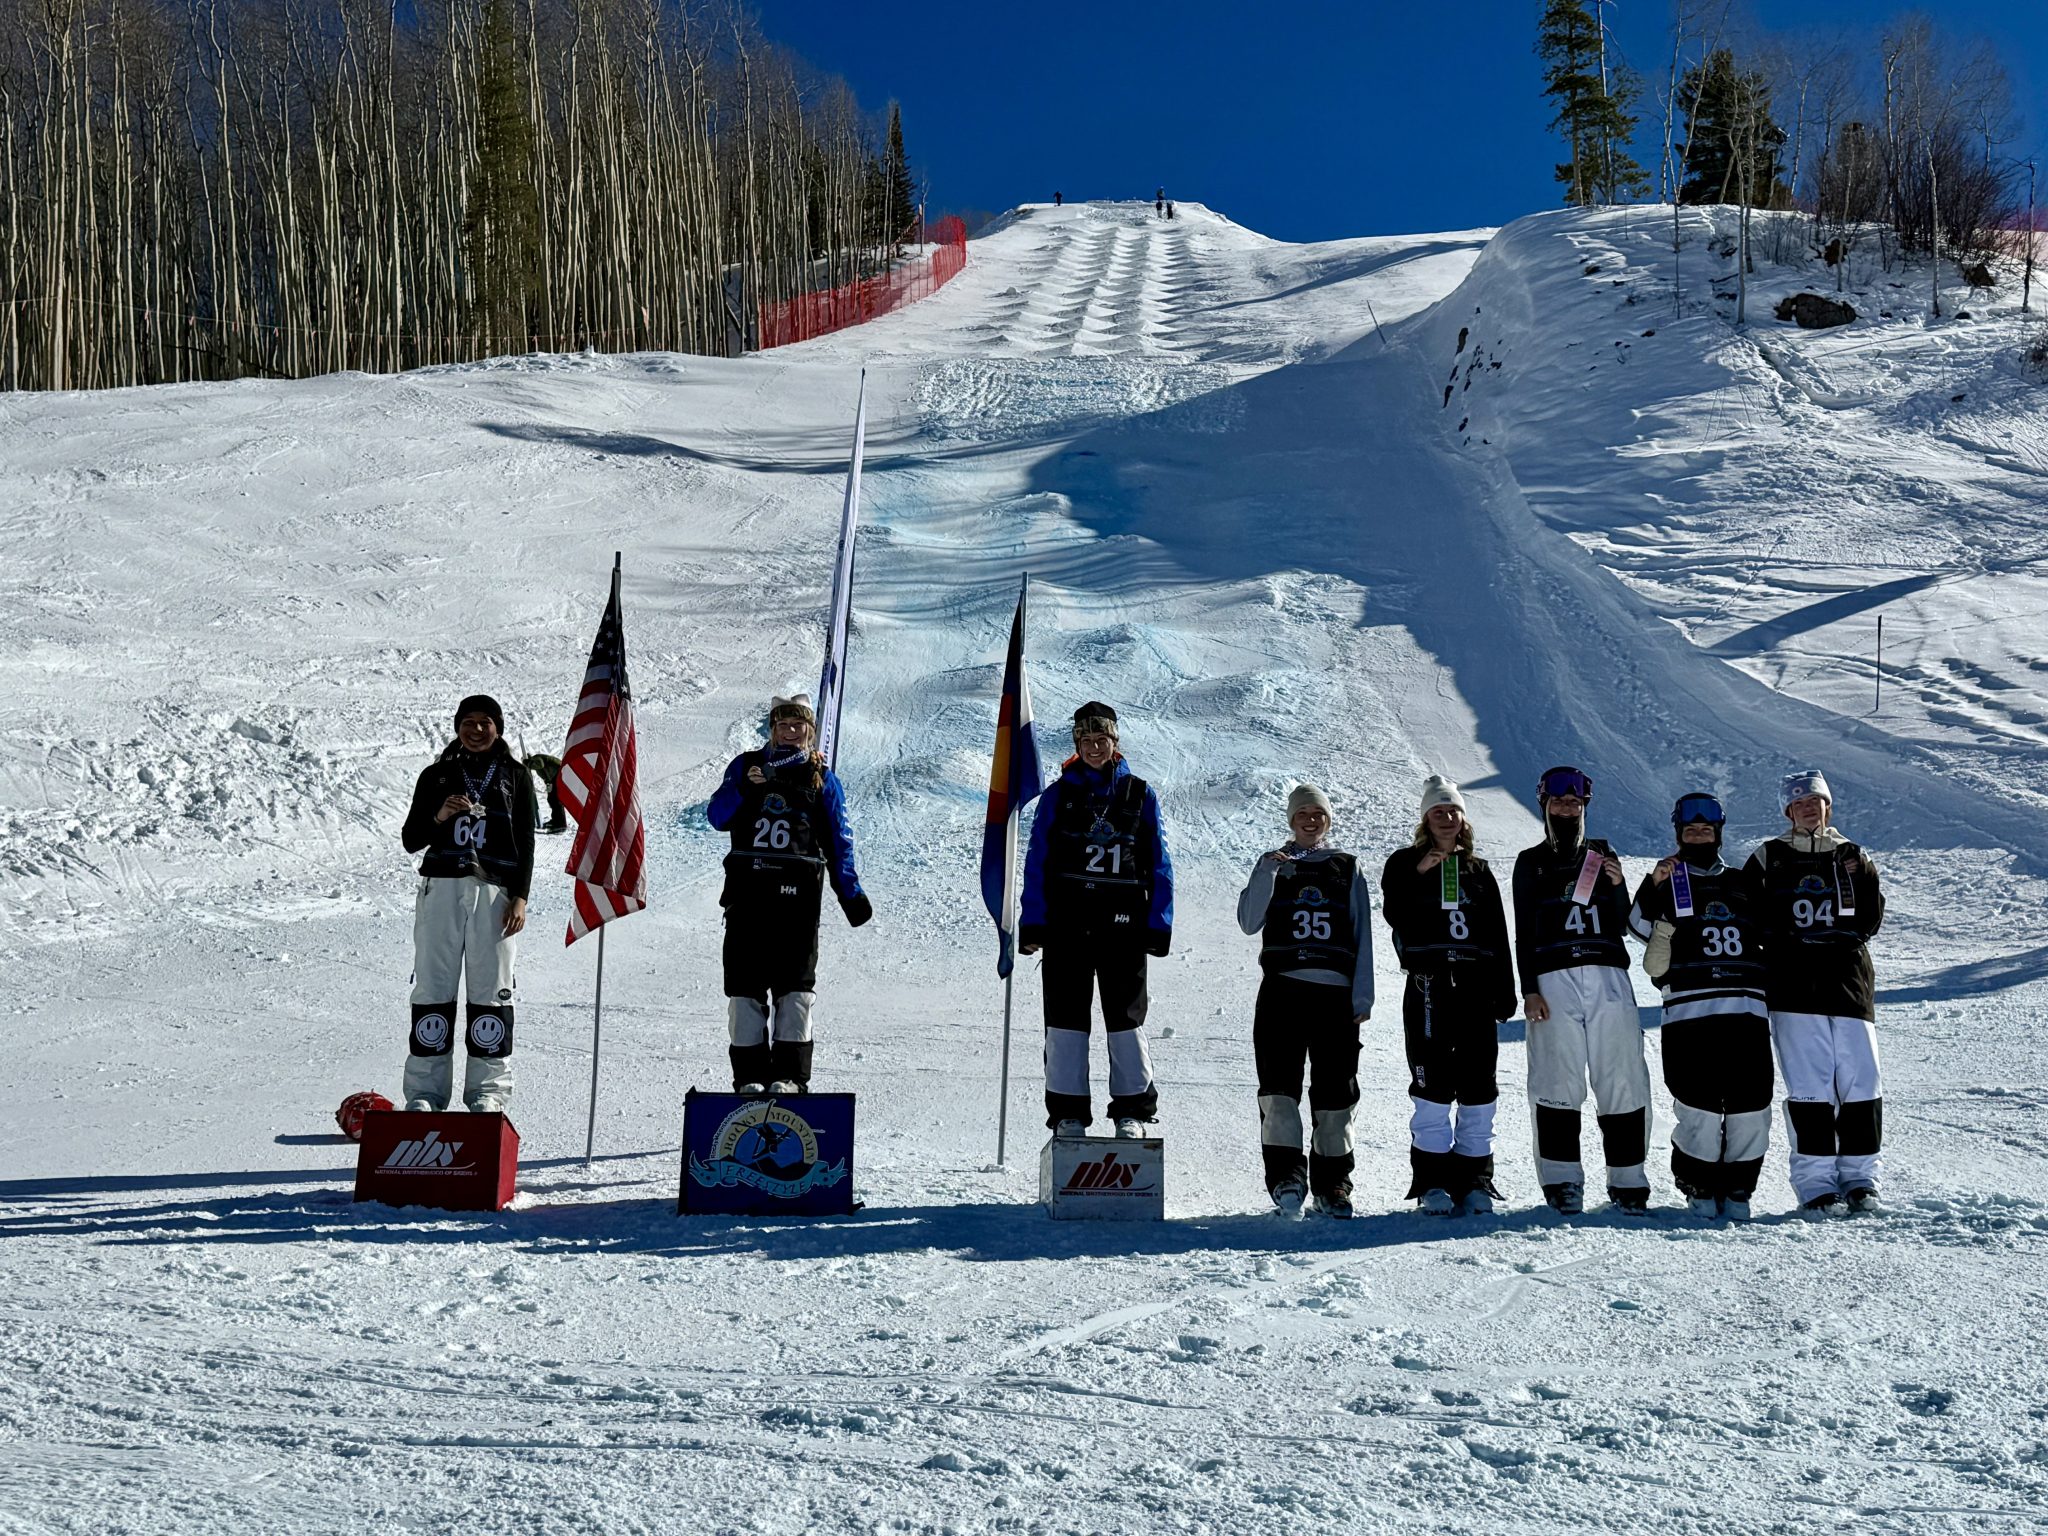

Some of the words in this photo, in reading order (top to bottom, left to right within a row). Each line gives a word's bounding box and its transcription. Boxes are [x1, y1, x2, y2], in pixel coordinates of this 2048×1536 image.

[454, 815, 487, 849] 64
[753, 817, 791, 849] 26
[1085, 844, 1121, 873] 21
[780, 885, 797, 895] HH
[1114, 914, 1130, 924] HH
[1292, 910, 1331, 940] 35
[1449, 910, 1469, 940] 8
[1564, 904, 1601, 935] 41
[1792, 899, 1835, 928] 94
[1702, 926, 1743, 957] 38
[725, 1165, 807, 1194] FREESTYLE
